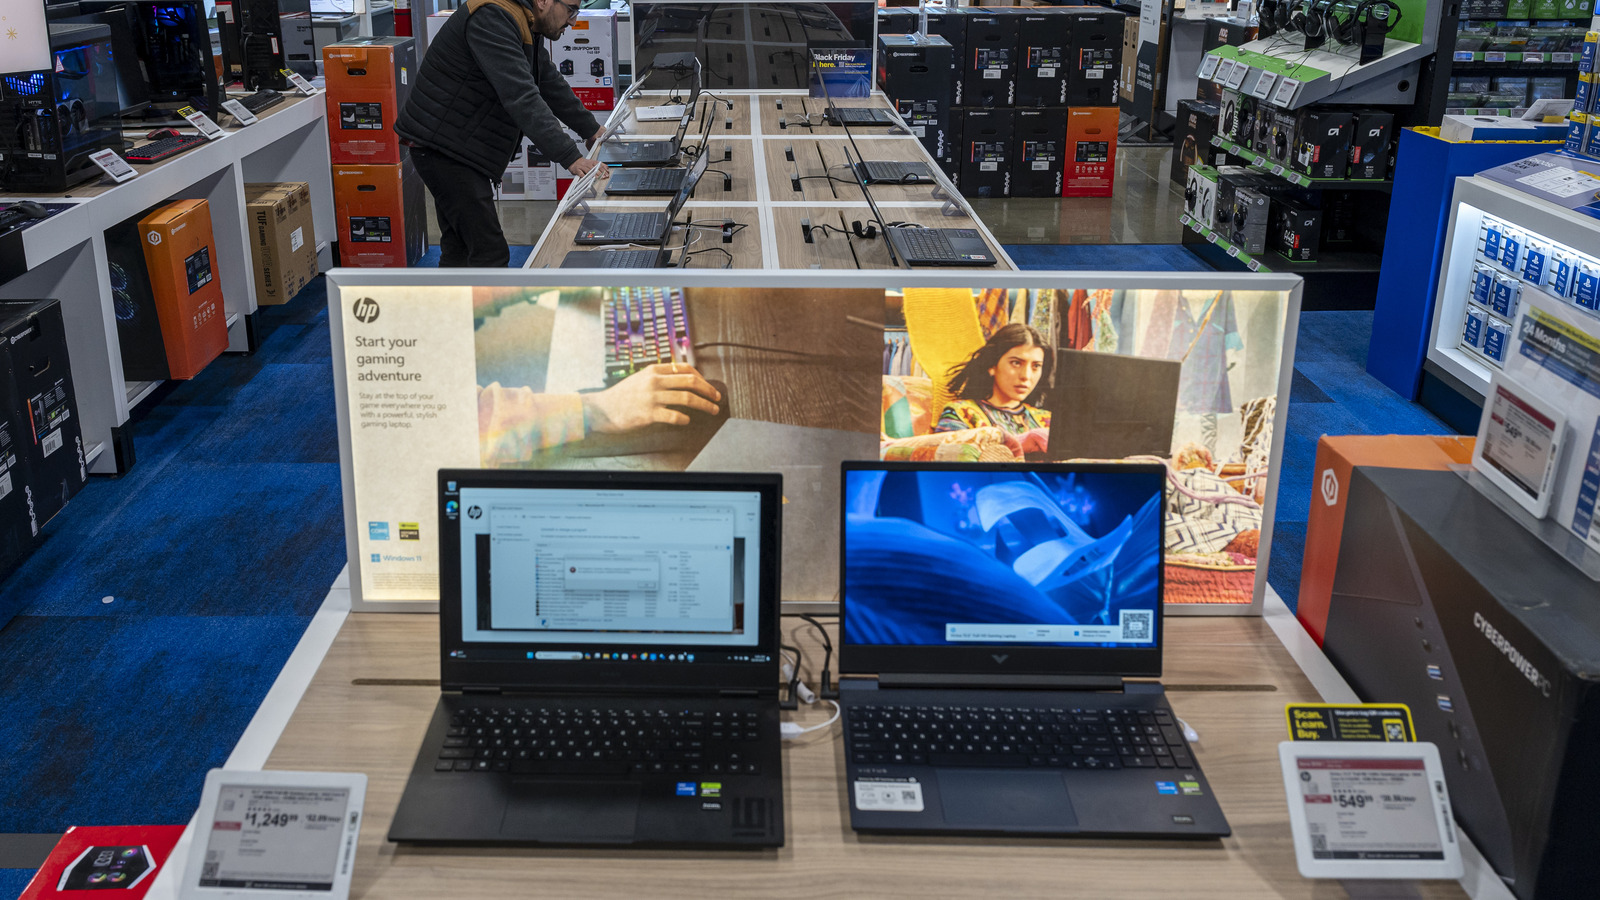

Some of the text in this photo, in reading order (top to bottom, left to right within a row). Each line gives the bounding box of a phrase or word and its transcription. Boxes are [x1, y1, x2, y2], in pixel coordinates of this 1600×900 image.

[834, 54, 855, 62] Friday
[257, 210, 267, 226] TUF
[263, 267, 272, 288] SERIES
[353, 297, 380, 324] hp
[355, 336, 418, 350] Start your
[1523, 321, 1534, 338] 24
[1533, 327, 1567, 354] Months
[356, 353, 405, 367] gaming
[357, 370, 422, 381] adventure
[359, 392, 374, 400] Stay
[396, 393, 408, 401] top
[382, 411, 415, 420] powerful,
[416, 412, 438, 420] stylish
[361, 421, 413, 429] gaming laptop.
[1473, 611, 1552, 698] CYBERPOWERPC
[1293, 709, 1323, 719] Scan.
[1295, 719, 1327, 729] Learn.
[1297, 729, 1320, 739] Buy.
